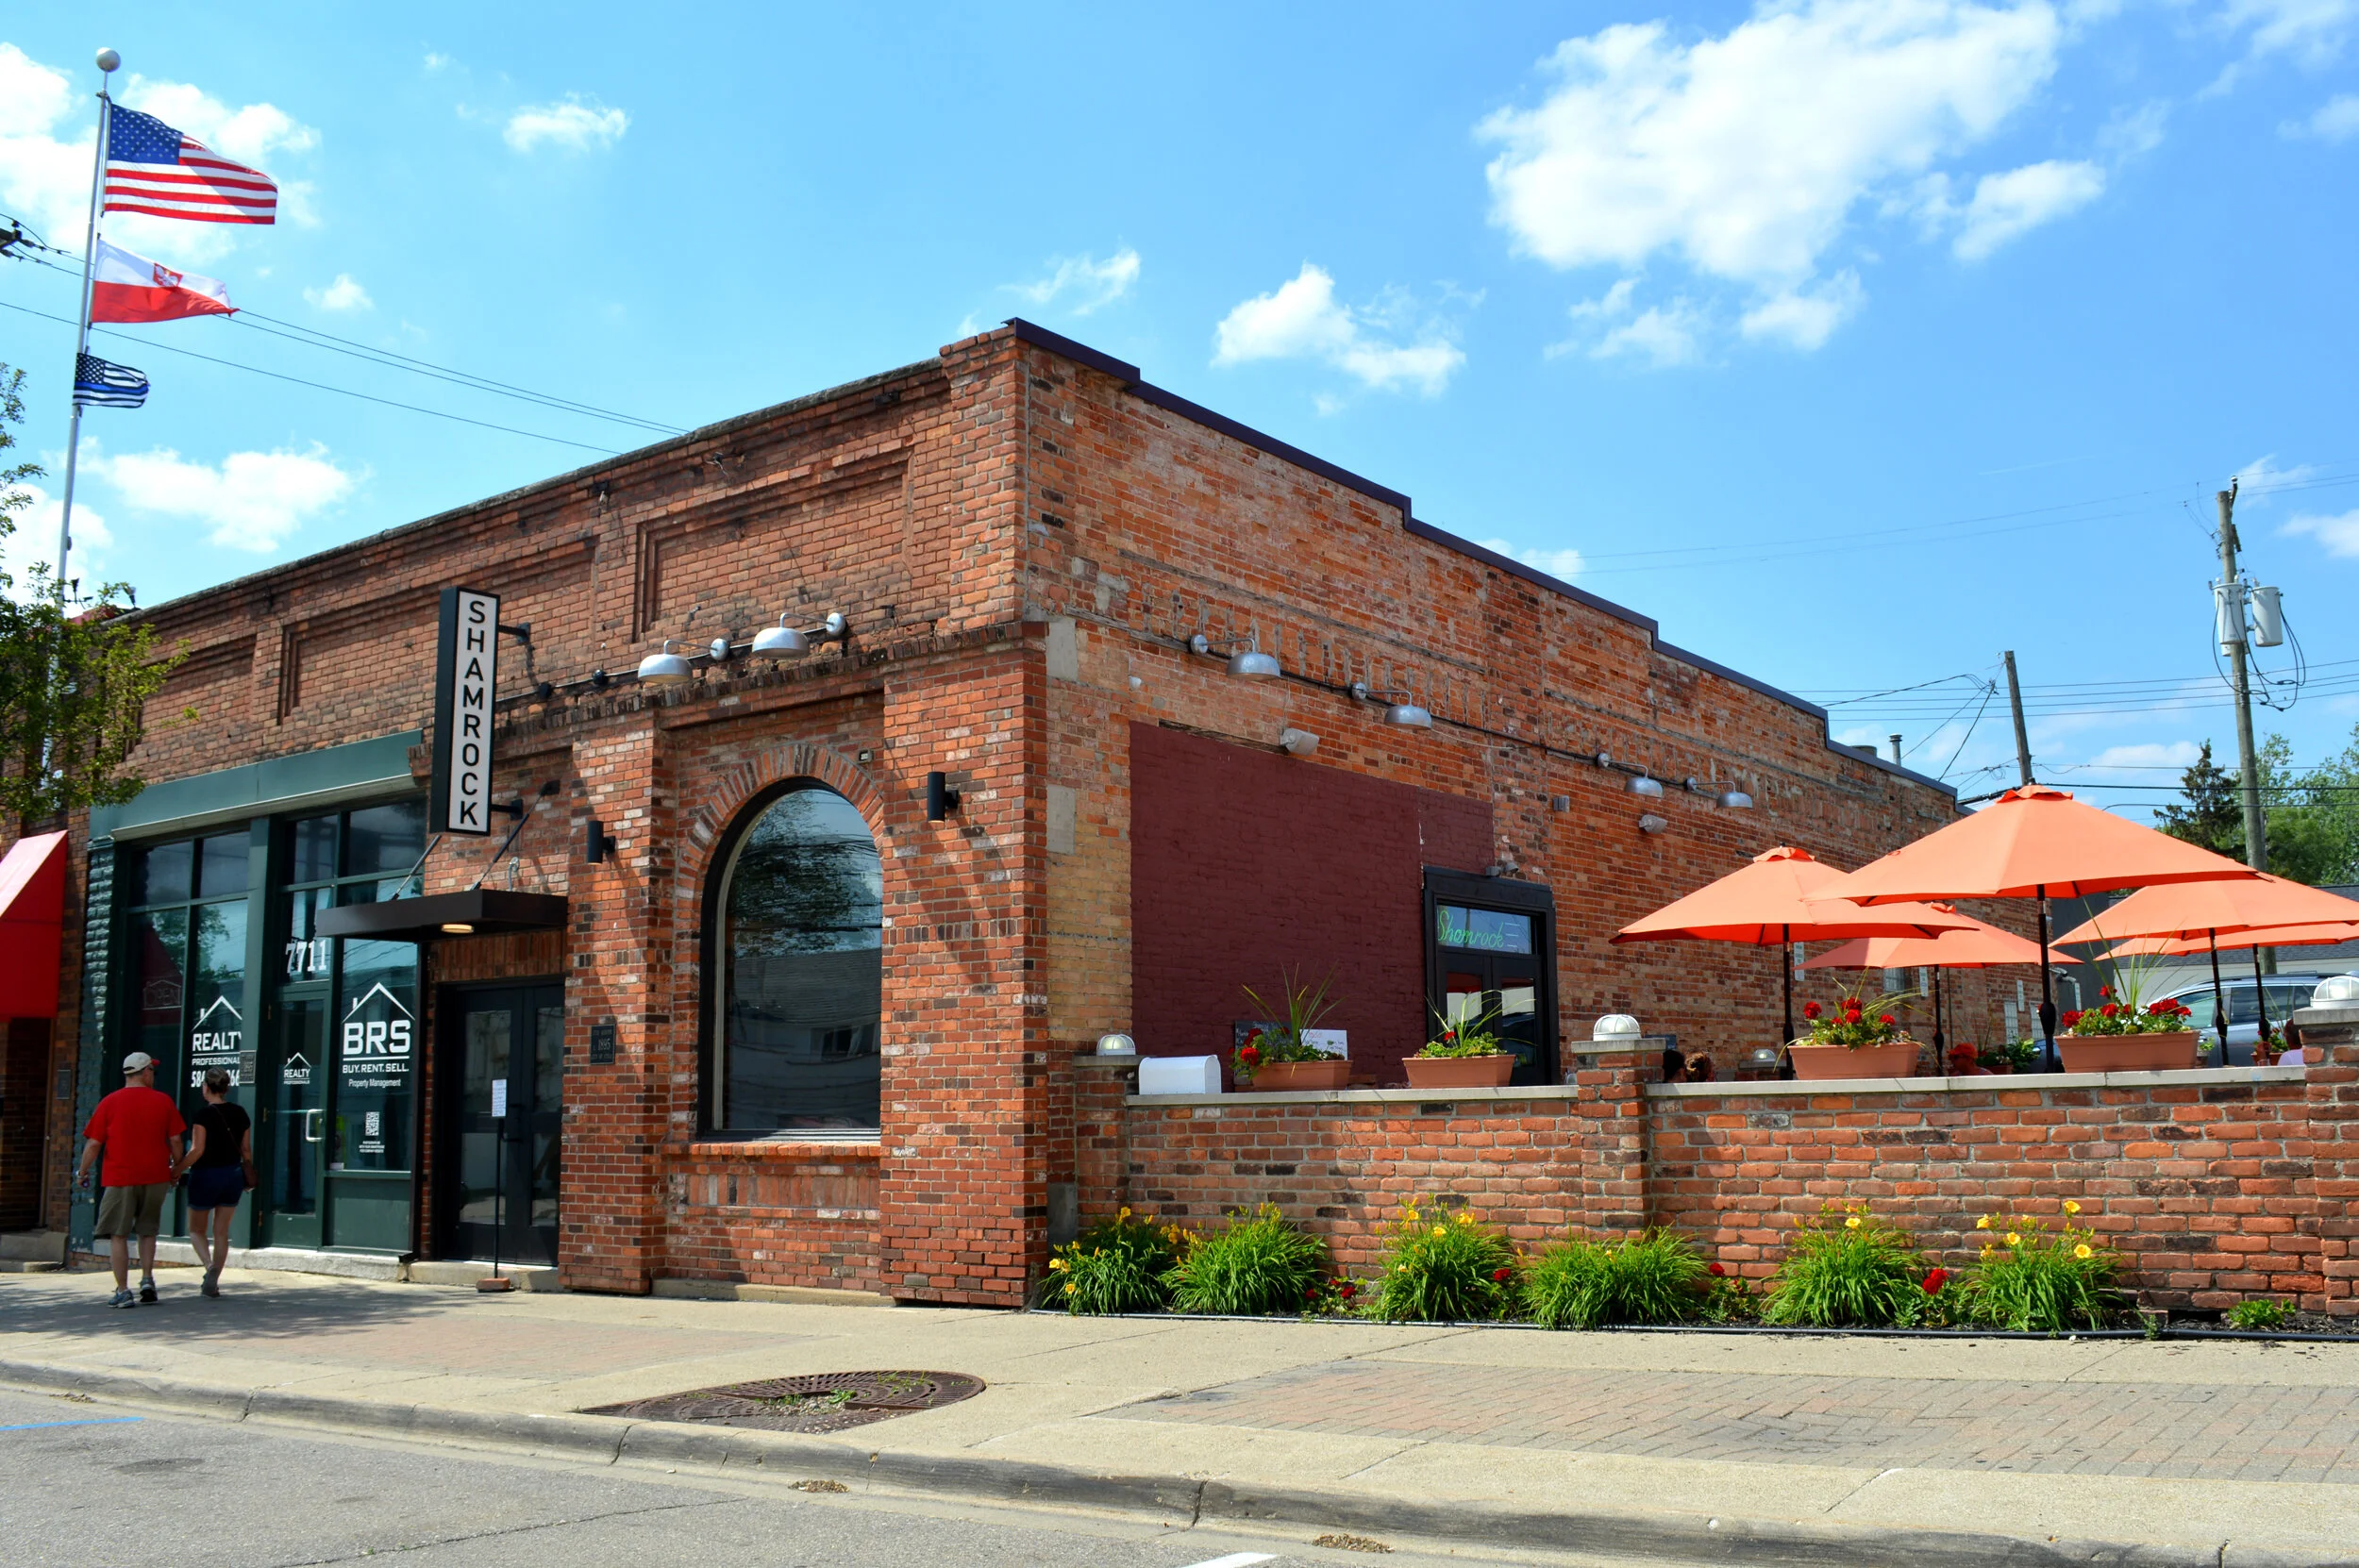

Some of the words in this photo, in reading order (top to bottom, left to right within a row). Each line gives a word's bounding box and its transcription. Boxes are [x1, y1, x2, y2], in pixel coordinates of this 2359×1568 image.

[460, 600, 486, 826] SHAMROCK
[1437, 909, 1504, 948] Shamrock
[285, 940, 327, 974] 7711
[343, 1020, 411, 1055] BRS
[192, 1057, 240, 1065] PROFESSIONAL
[283, 1068, 310, 1078] REALTY
[348, 1078, 368, 1089] Property
[369, 1078, 401, 1088] Management
